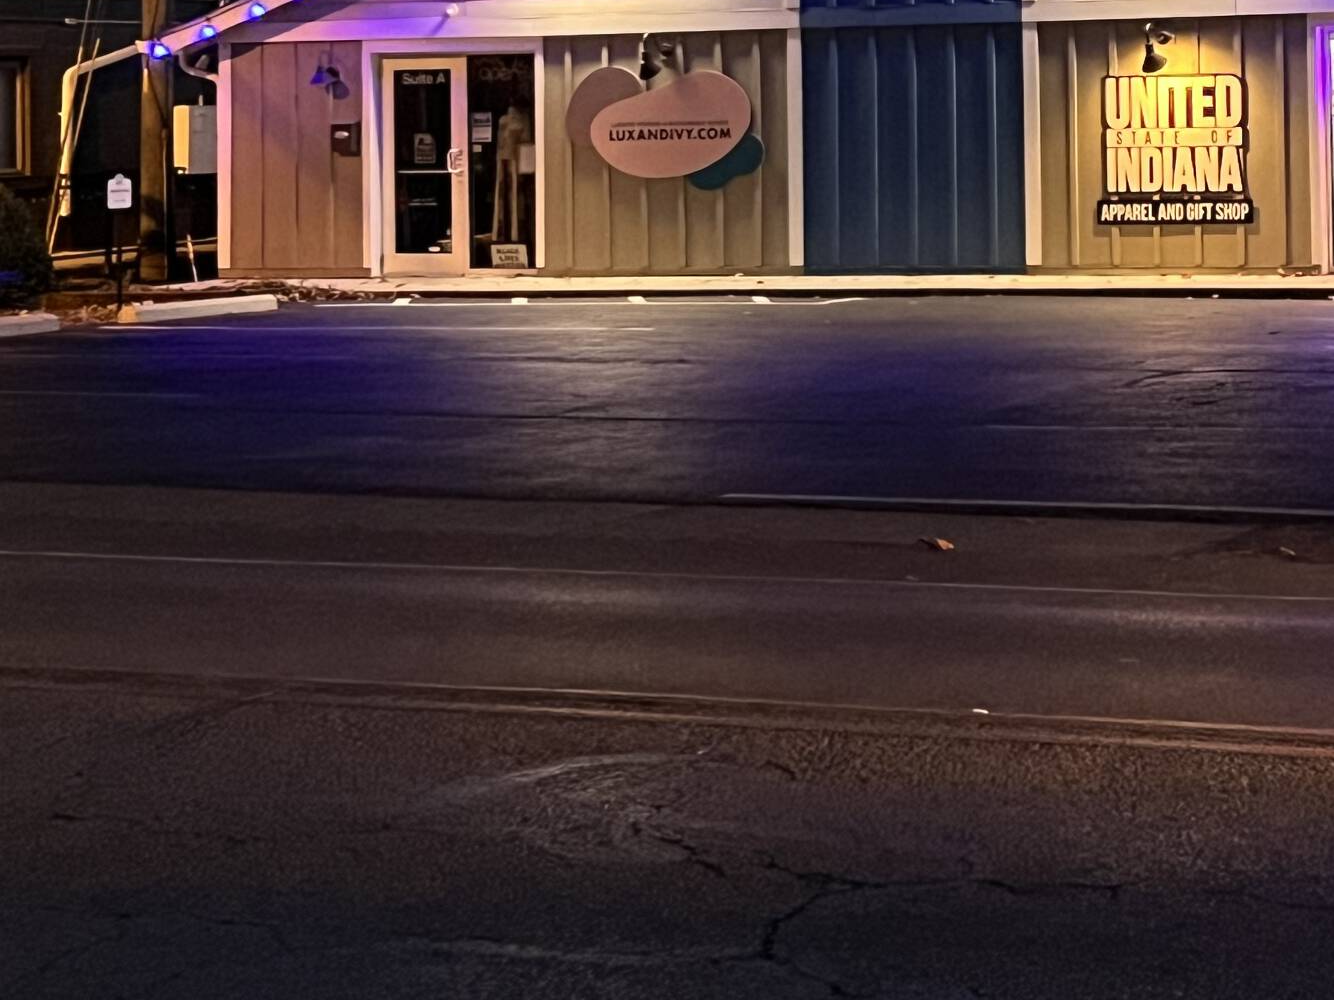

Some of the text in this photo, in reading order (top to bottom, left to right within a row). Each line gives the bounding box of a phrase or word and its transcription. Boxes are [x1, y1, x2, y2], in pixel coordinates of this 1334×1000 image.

[402, 72, 446, 85] Suite A
[1105, 75, 1243, 130] UNITED
[609, 128, 732, 141] LUXANDIVY.COM
[1116, 130, 1233, 145] STATE OF
[1106, 147, 1243, 192] INDIANA
[1101, 203, 1249, 221] APPAREL AND GIFT SHOP
